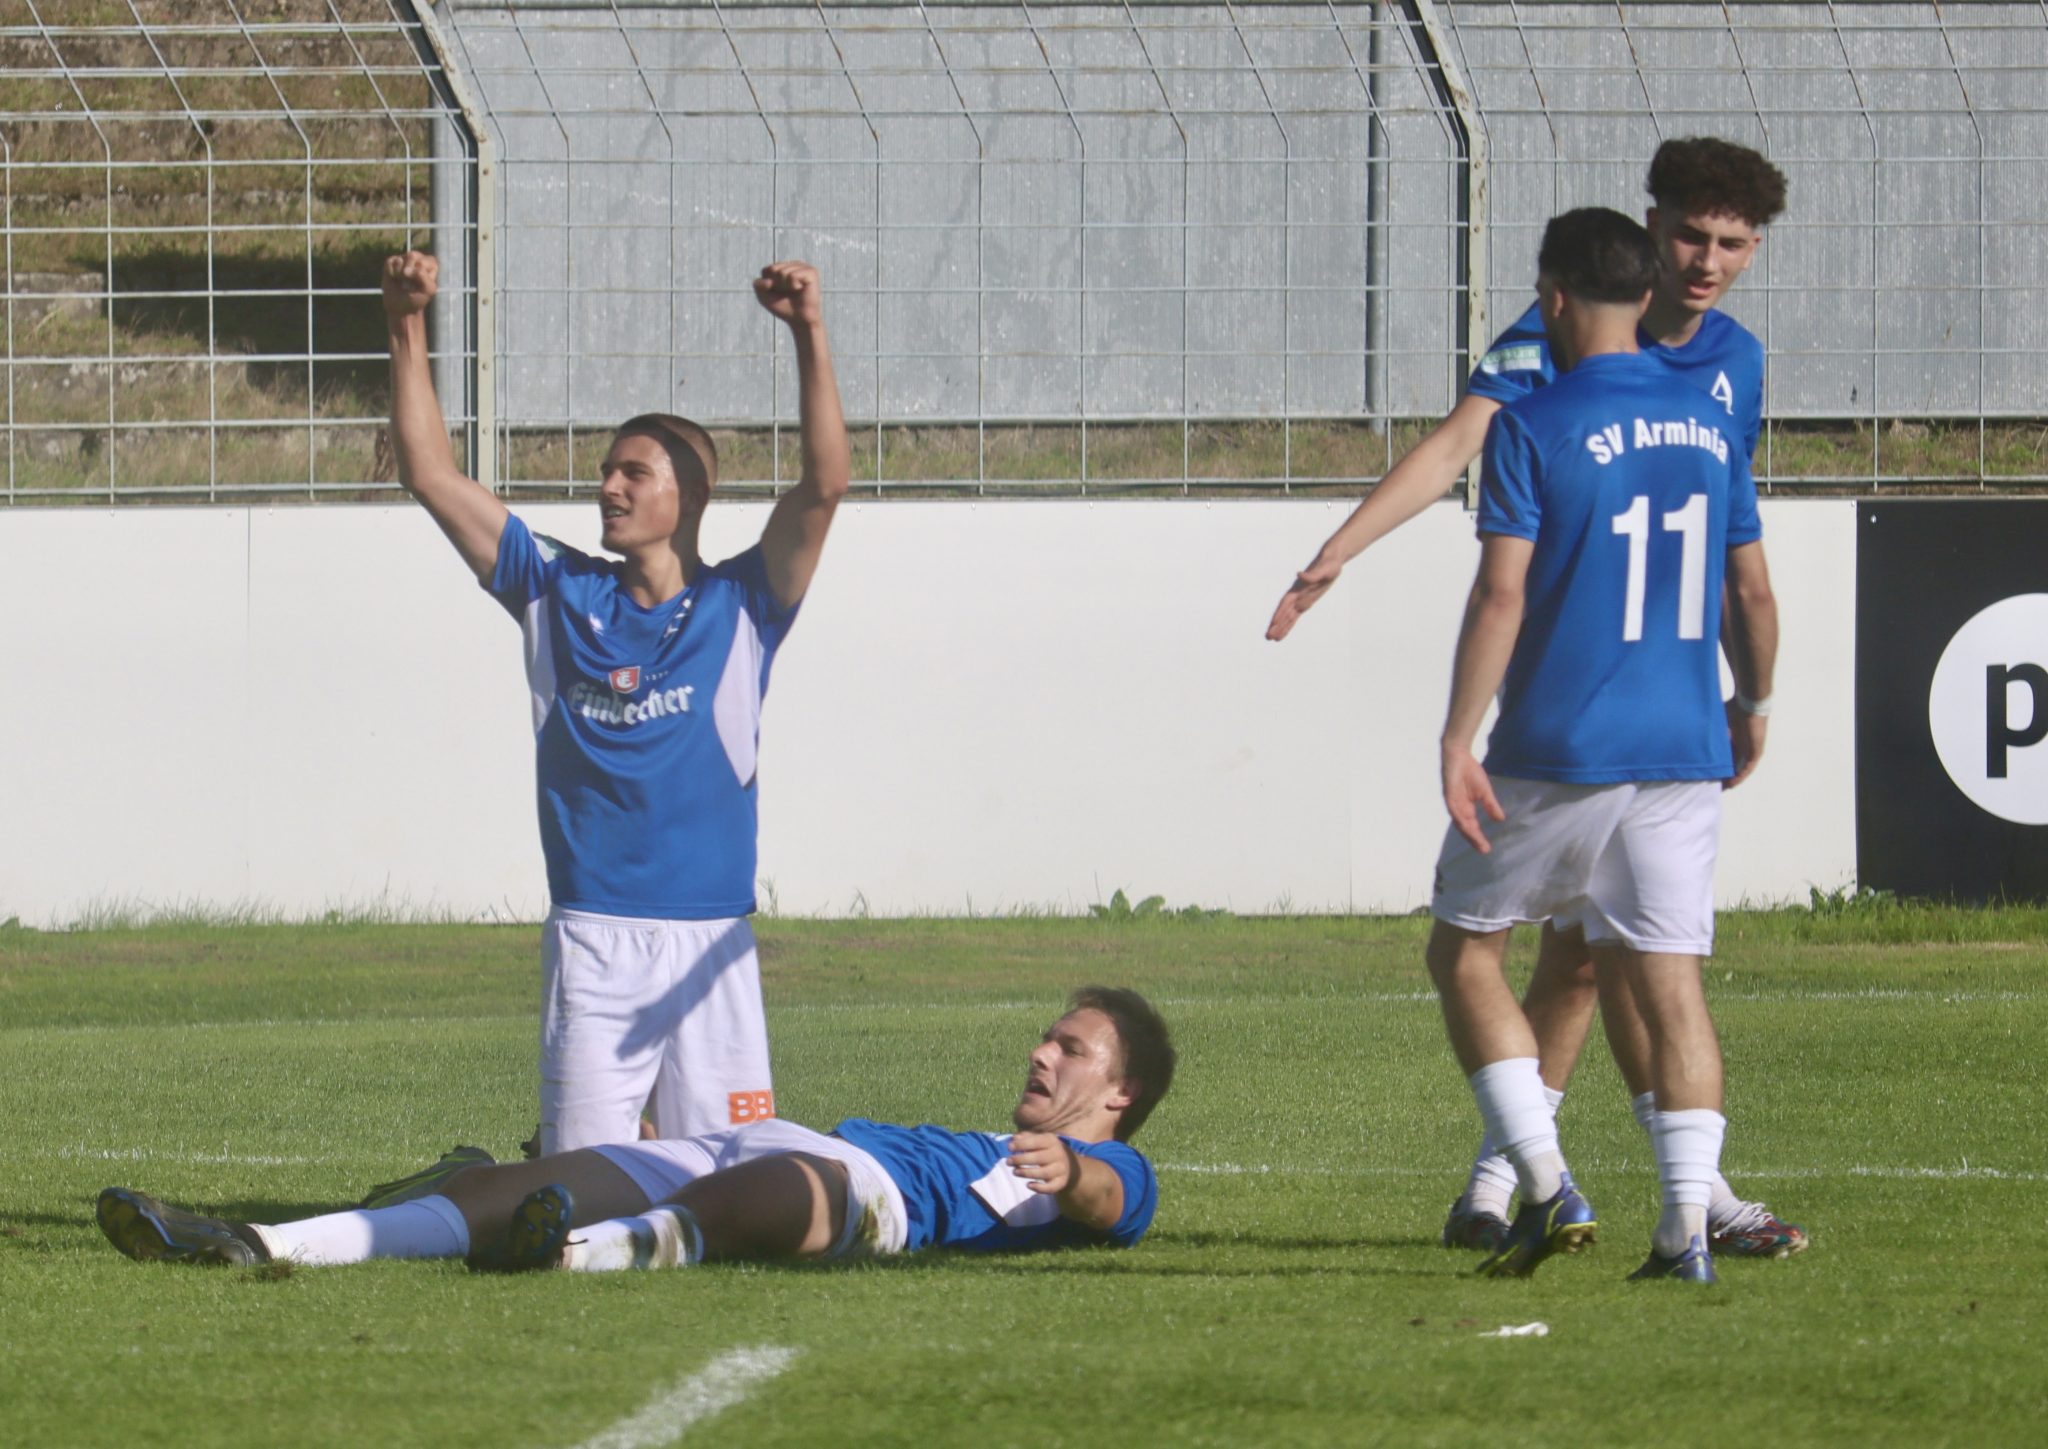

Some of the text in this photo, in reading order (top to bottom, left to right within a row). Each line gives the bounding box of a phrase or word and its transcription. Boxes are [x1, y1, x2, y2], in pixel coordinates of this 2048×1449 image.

[1585, 416, 1729, 466] SV Arminia
[1611, 493, 1708, 642] 11
